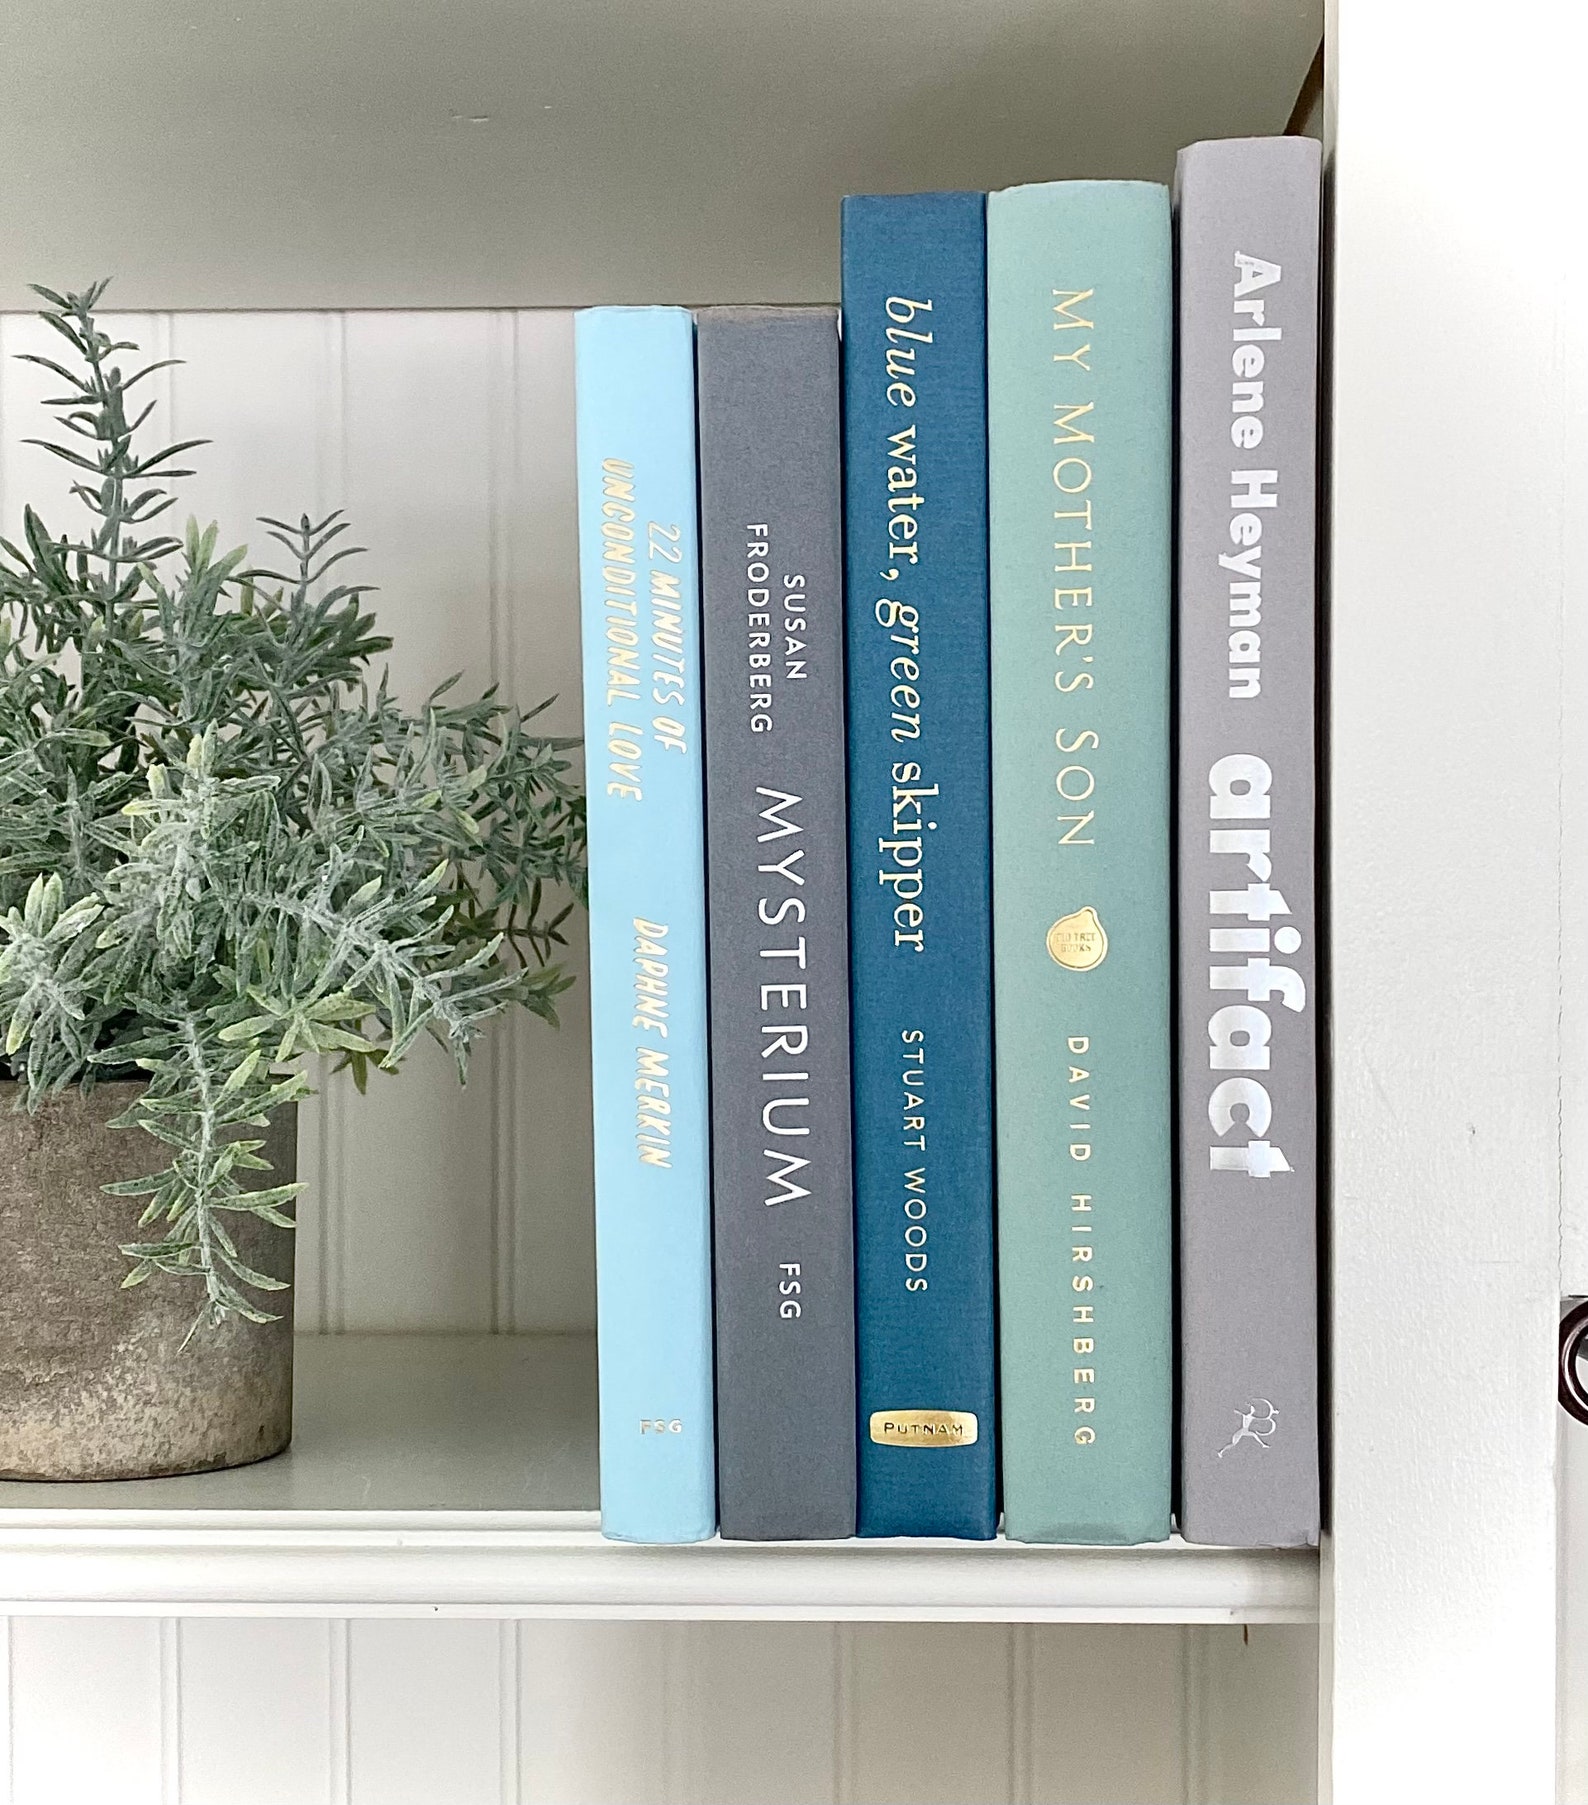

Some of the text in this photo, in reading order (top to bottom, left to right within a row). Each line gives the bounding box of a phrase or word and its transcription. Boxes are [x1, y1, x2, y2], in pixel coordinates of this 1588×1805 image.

[1052, 288, 1100, 846] MY MOTHER'S SON
[1218, 251, 1283, 699] Arlene Heyman
[602, 458, 643, 801] UNCONDITIONAL LOVE
[648, 521, 687, 754] 22 MINUTES OF
[746, 523, 773, 733] FRODERBERG
[783, 574, 808, 680] SUSAN
[875, 296, 940, 953] blue water, green skipper
[632, 917, 673, 1168] DAPHNE MERKIN
[755, 786, 812, 1206] MYSTERIUM
[1207, 753, 1306, 1178] artifact
[778, 1262, 801, 1319] FSG
[902, 1030, 928, 1292] STUART WOODS
[1067, 1036, 1096, 1446] DAVID HIRSHBERG
[639, 1418, 682, 1434] FSG
[884, 1422, 963, 1436] PUTNAM
